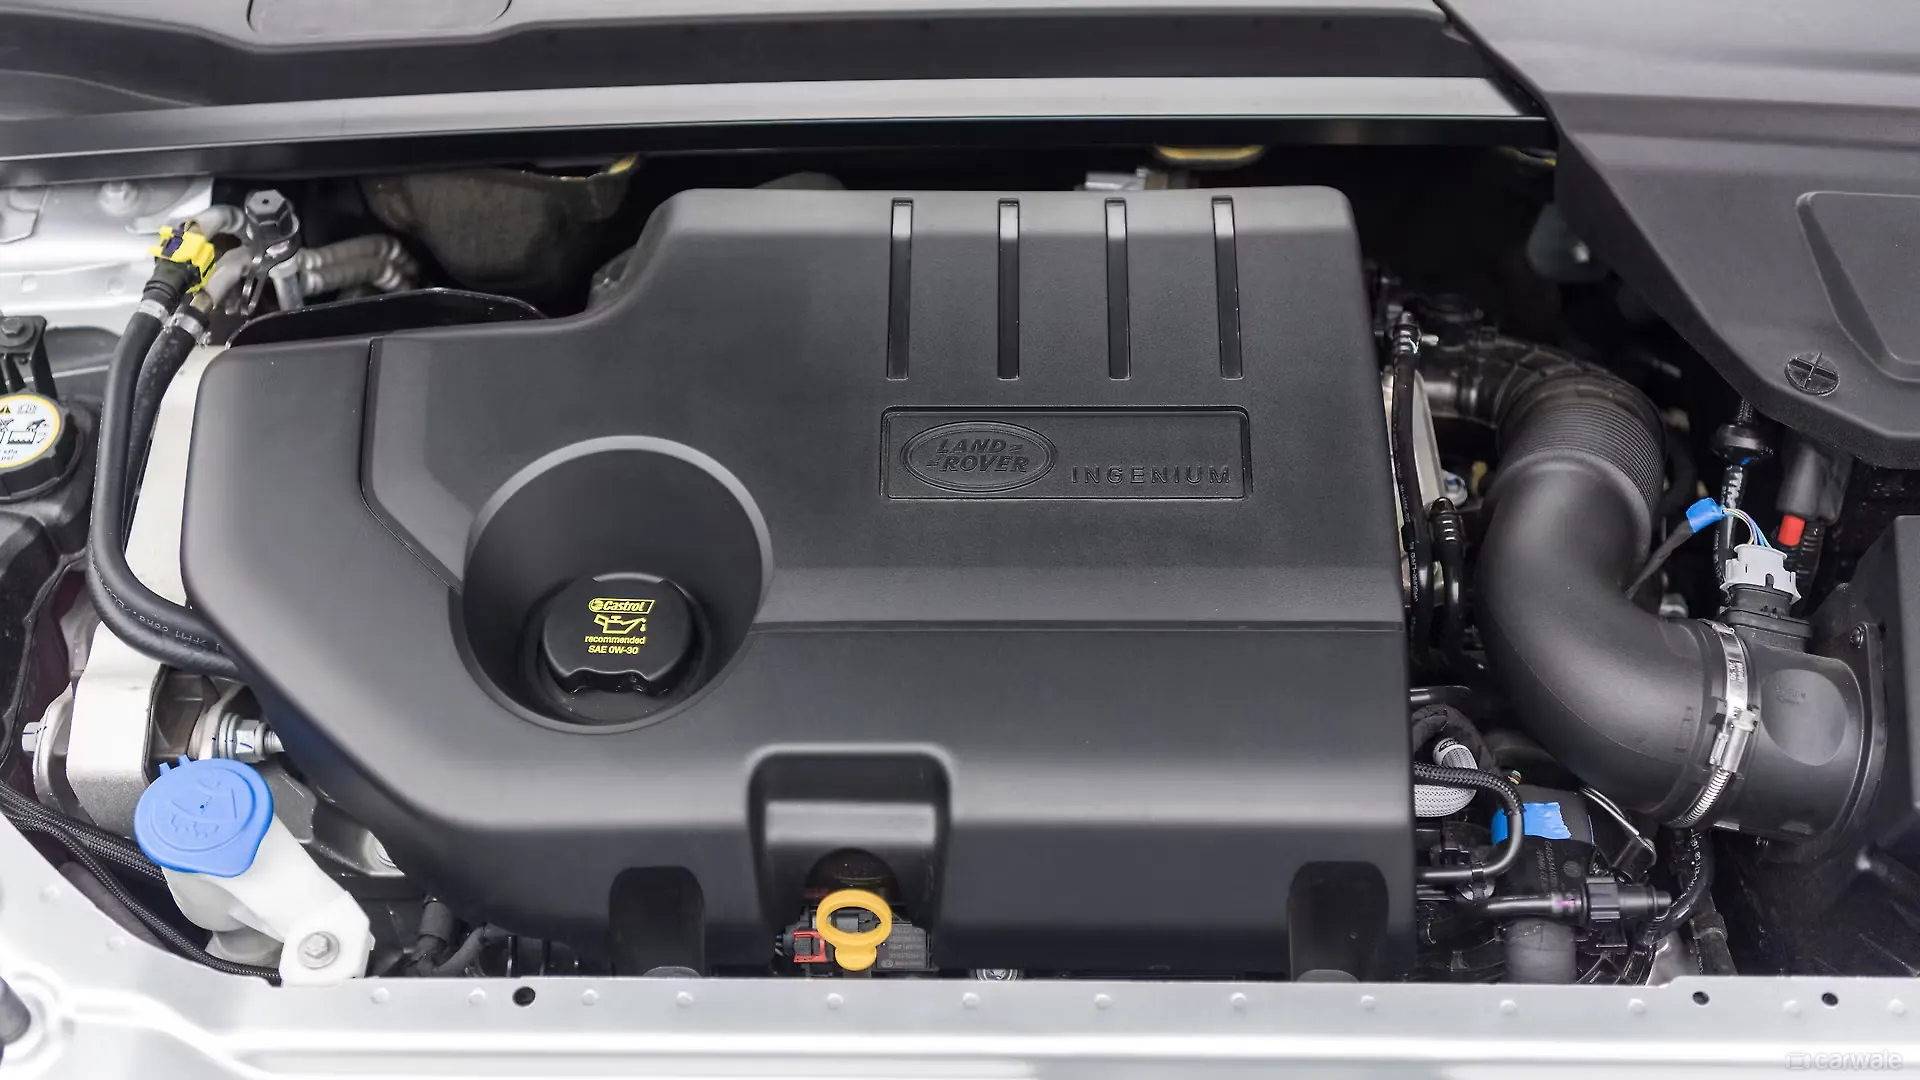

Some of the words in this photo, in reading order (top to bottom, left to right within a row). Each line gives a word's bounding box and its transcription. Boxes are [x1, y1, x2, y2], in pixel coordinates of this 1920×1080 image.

[936, 438, 1007, 453] LAND
[939, 455, 1030, 473] ROVER
[1070, 465, 1231, 485] INGENIUM
[602, 600, 646, 612] Castrol
[584, 635, 646, 645] recommended
[587, 645, 607, 654] SAE
[608, 645, 639, 655] 0W-30
